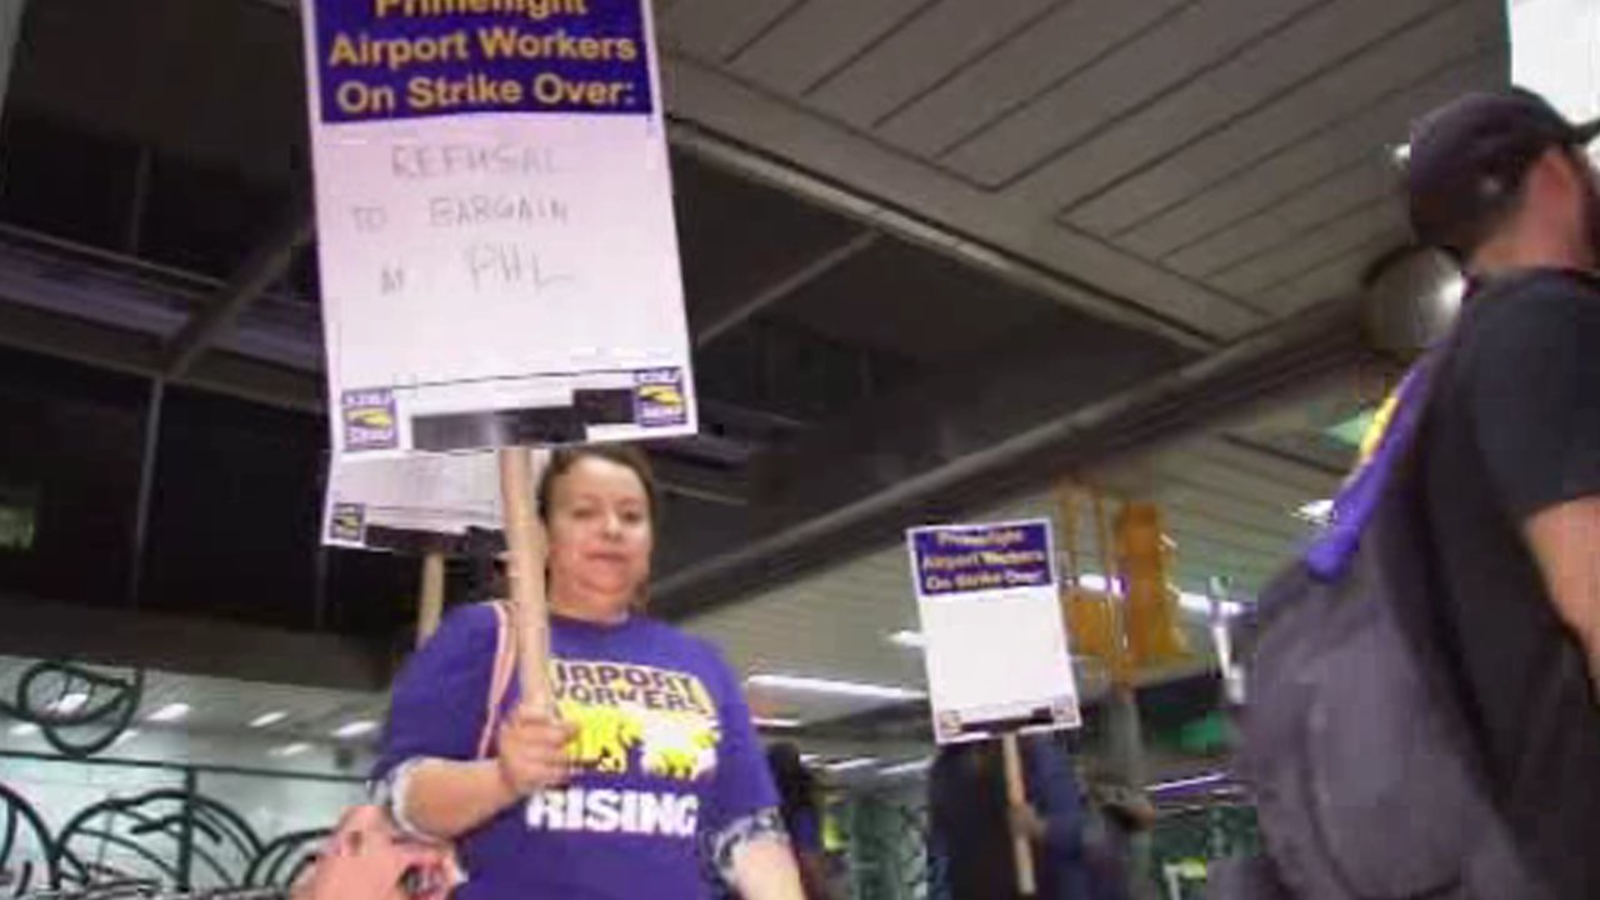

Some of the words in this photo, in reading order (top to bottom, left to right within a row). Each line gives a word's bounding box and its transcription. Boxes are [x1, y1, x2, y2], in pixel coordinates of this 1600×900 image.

[329, 32, 468, 69] Airport
[477, 28, 637, 60] Workers
[337, 81, 396, 113] On
[407, 77, 523, 108] Strike
[534, 73, 635, 104] Over:
[429, 198, 568, 227] BARGAIN
[551, 663, 700, 698] IRPORT
[526, 786, 698, 837] RISING
